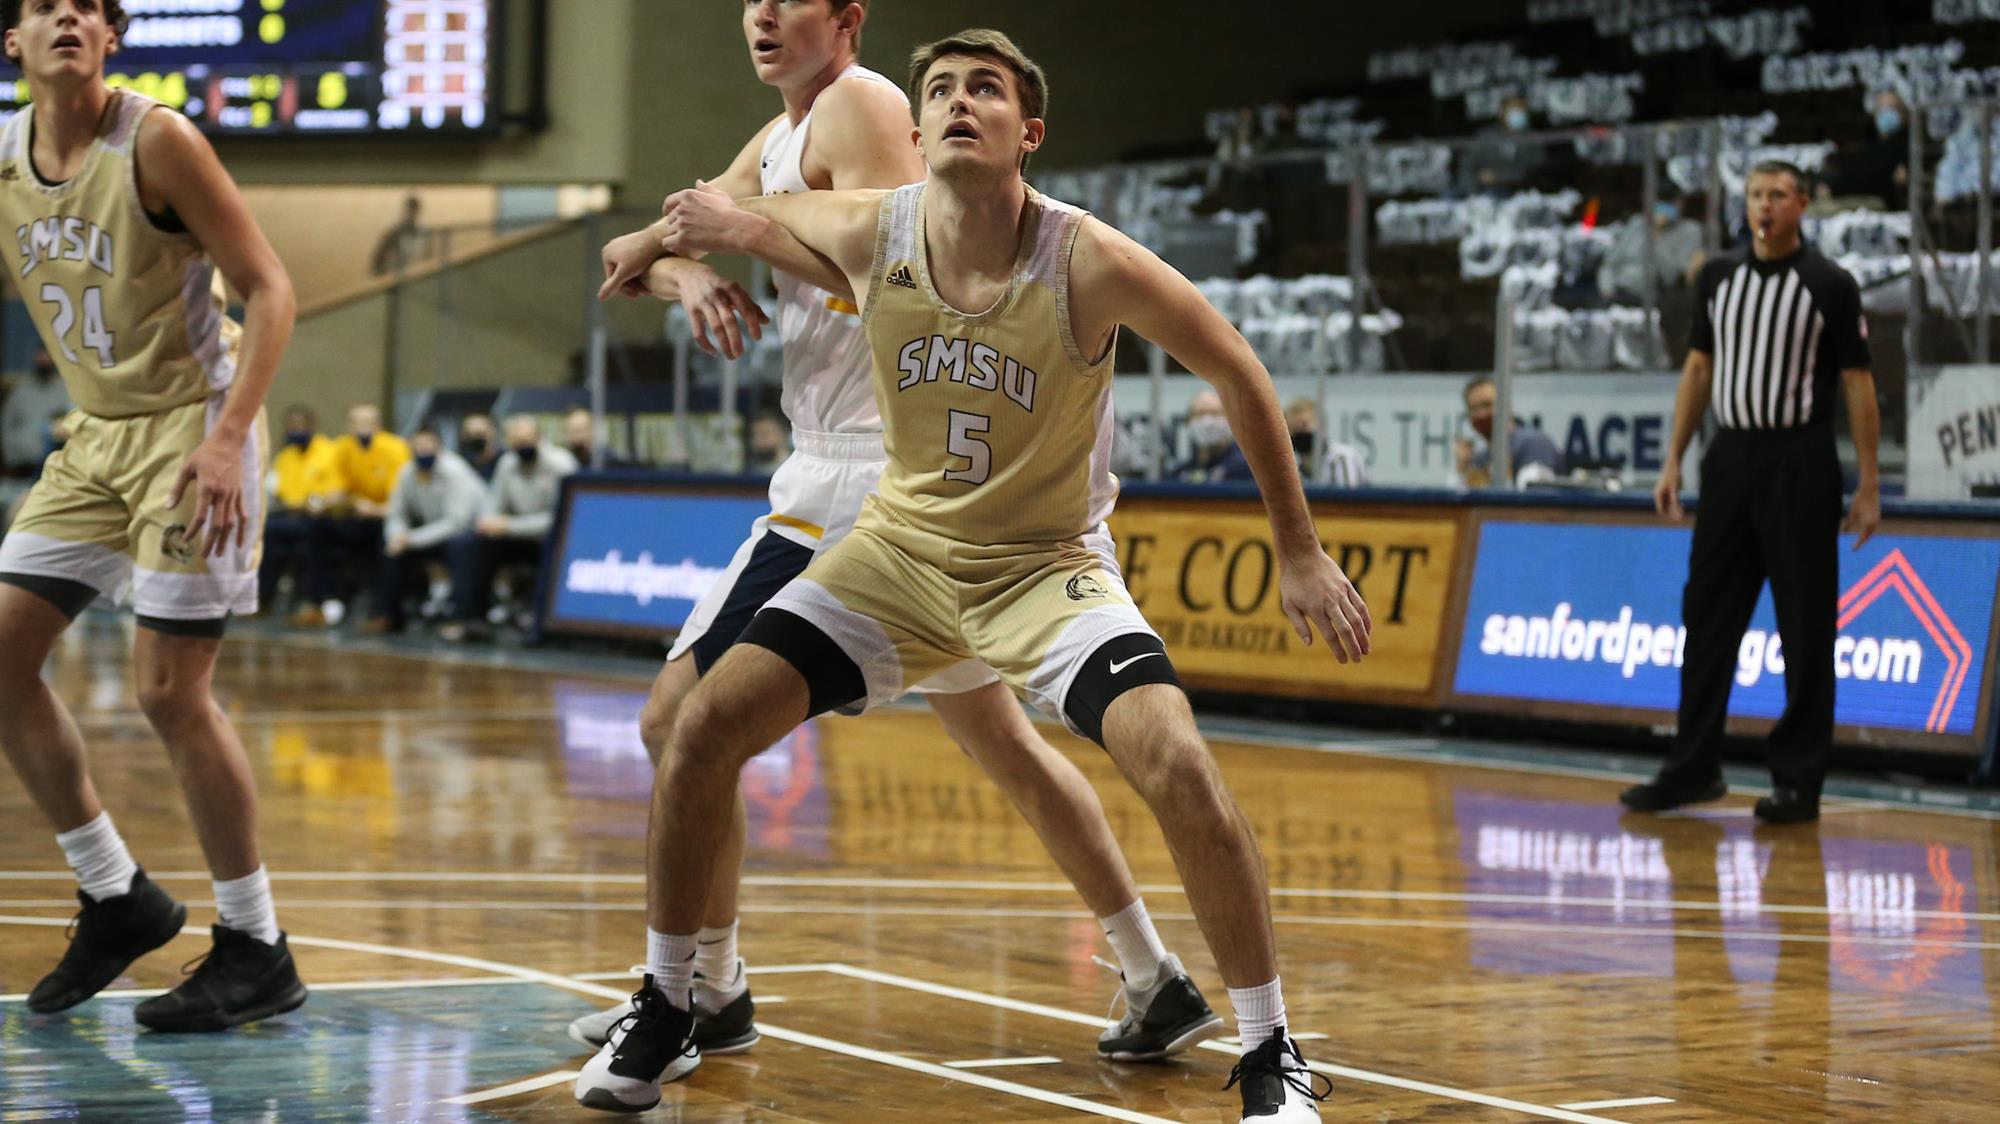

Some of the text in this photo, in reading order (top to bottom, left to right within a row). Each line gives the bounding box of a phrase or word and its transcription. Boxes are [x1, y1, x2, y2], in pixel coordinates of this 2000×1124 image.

[16, 215, 114, 279] SMSU
[886, 276, 917, 290] adidas
[41, 282, 116, 369] 24
[898, 334, 1037, 414] SMSU
[943, 408, 992, 487] 5
[1392, 411, 1466, 469] TH
[1511, 413, 1664, 471] ACE
[1937, 404, 2000, 470] PEN
[1177, 535, 1430, 625] CORT
